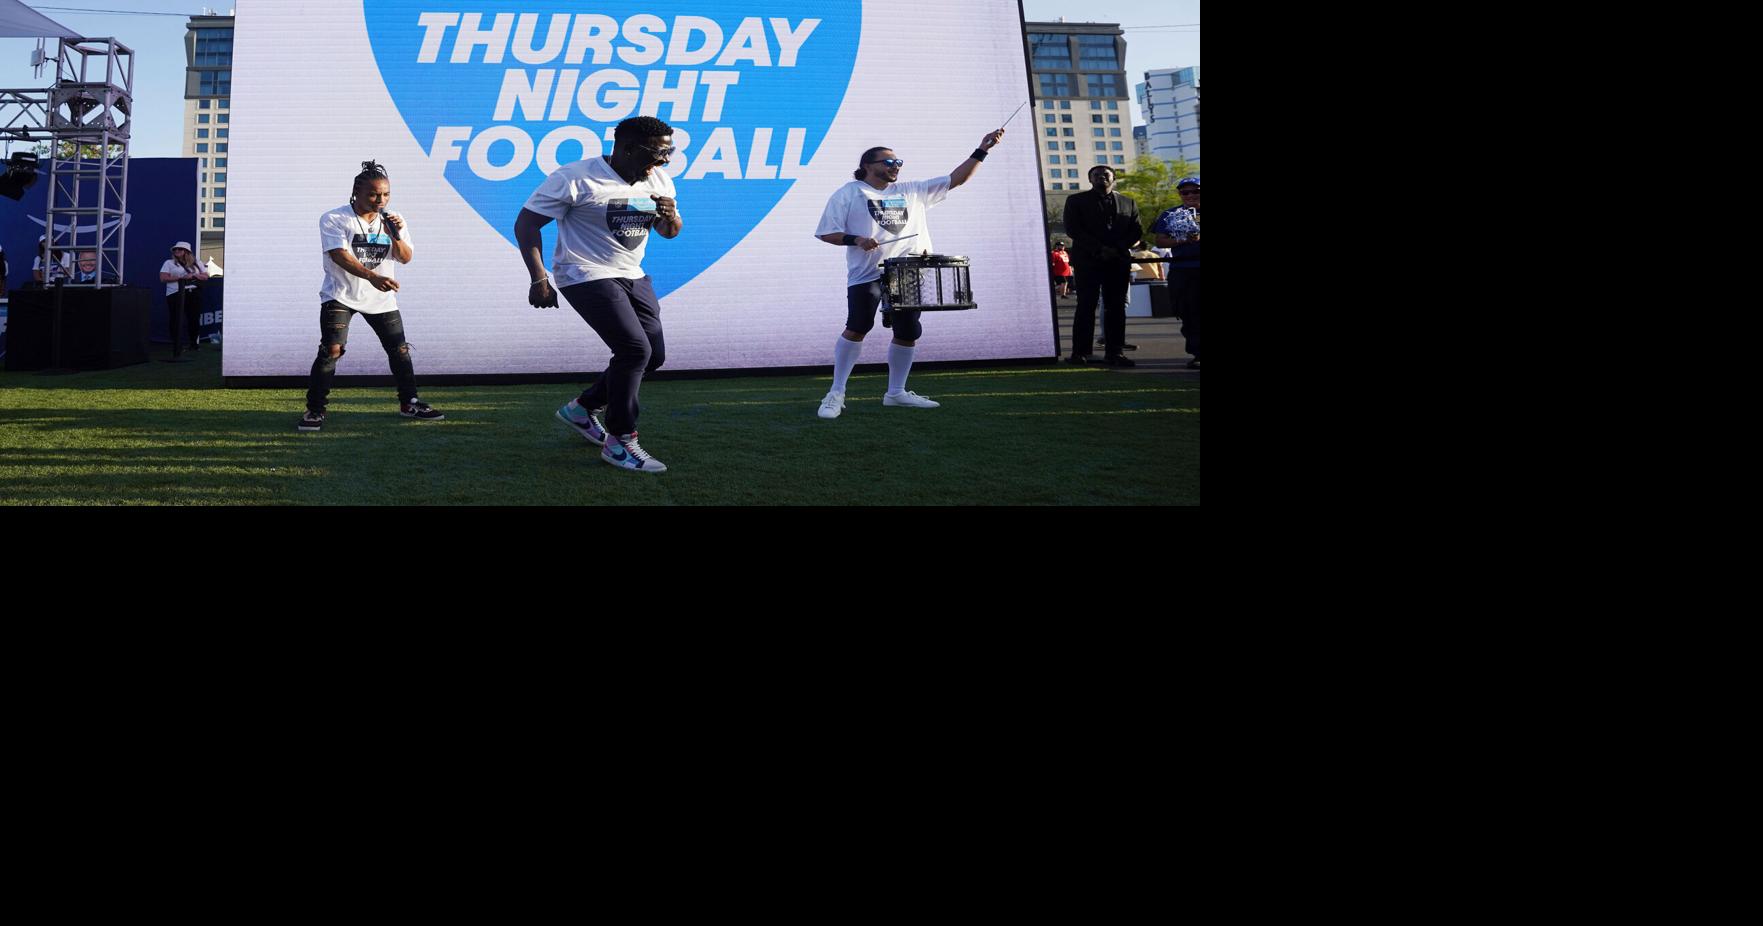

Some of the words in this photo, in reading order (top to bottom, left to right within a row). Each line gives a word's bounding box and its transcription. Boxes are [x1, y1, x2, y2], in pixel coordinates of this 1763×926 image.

[416, 11, 823, 68] THURSDAY
[492, 68, 741, 122] NIGHT
[428, 125, 809, 181] FOOBALL
